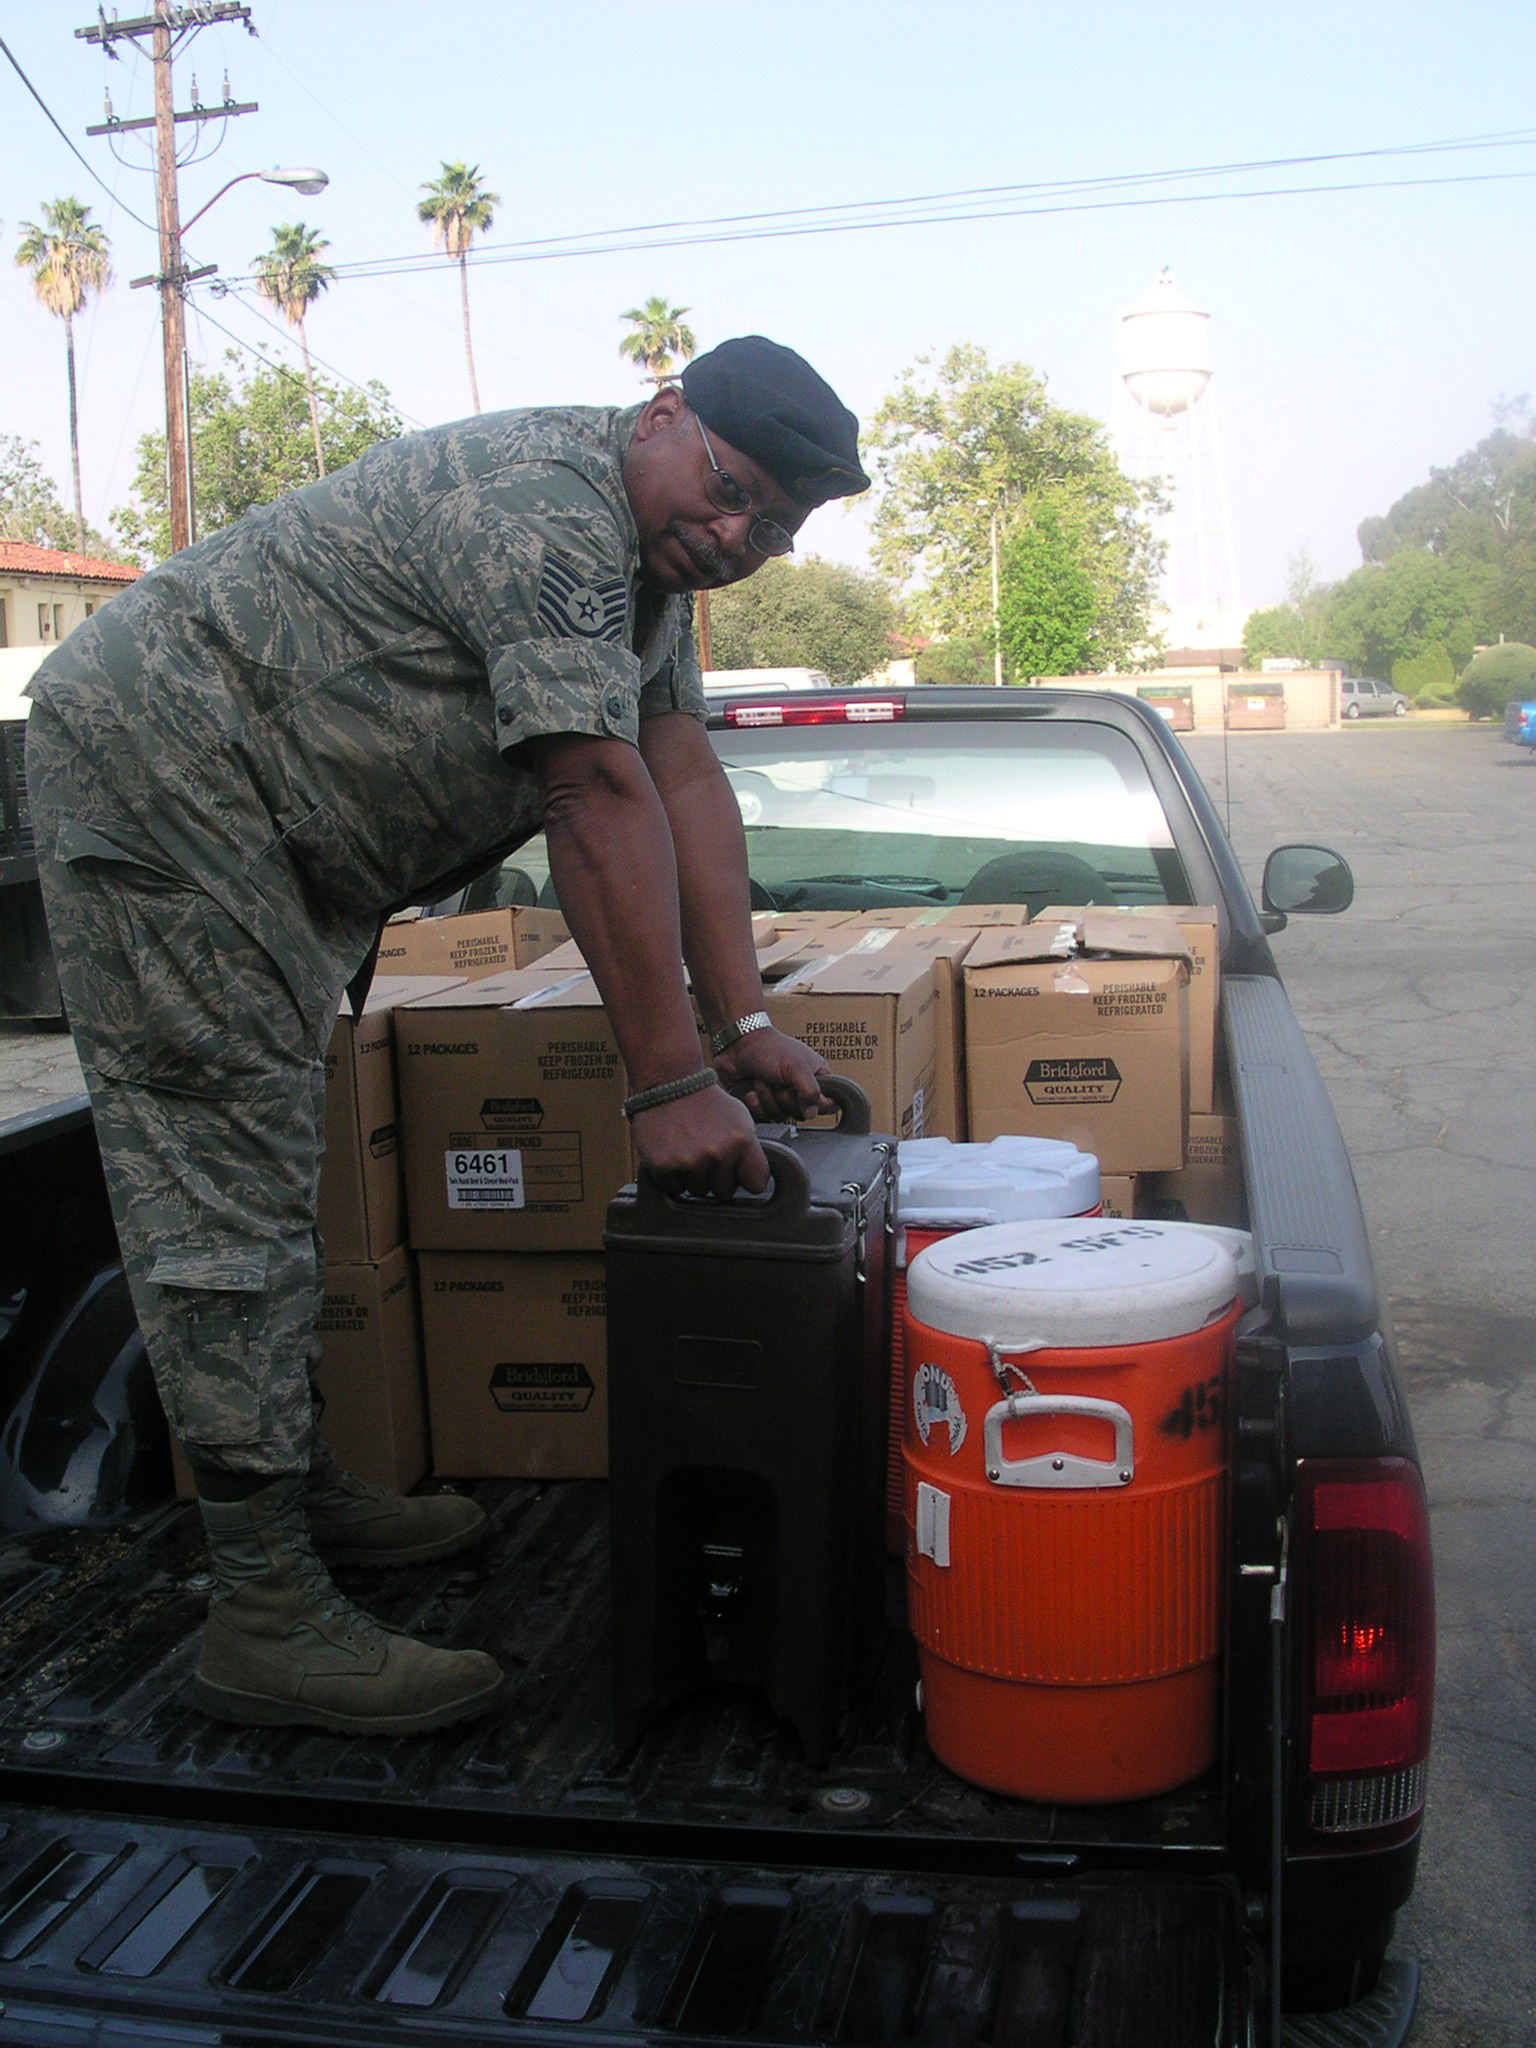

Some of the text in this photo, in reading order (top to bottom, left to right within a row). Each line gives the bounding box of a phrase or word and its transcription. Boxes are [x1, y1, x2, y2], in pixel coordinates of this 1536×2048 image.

[457, 935, 500, 949] PERISHABLE
[378, 947, 407, 959] CKAGES
[450, 949, 468, 959] KEEP
[469, 947, 497, 957] FROZEN
[454, 954, 506, 969] REFRIGERATED
[973, 986, 1040, 998] 12 PACKAGES
[1103, 982, 1157, 994] PERISHABLE
[1093, 992, 1167, 1005] KEEP FROZEN OR
[1097, 1004, 1163, 1017] REFRIGERATED
[806, 1022, 867, 1034] PERISHABLE
[548, 1041, 607, 1053] PERISHABLE
[823, 1035, 862, 1047] FROZEN
[864, 1035, 878, 1046] OR
[407, 1043, 479, 1056] 12 PACKAGES
[537, 1053, 619, 1068] KEEP FROZEN OR
[543, 1067, 614, 1081] REFRIGERATED
[1040, 1061, 1107, 1080] Bridgford
[1044, 1085, 1104, 1095] QUALITY
[455, 1154, 508, 1174] 6461
[433, 1280, 505, 1292] 12 PACKAGES
[572, 1279, 607, 1291] PERISH
[322, 1294, 357, 1305] SHABLE
[561, 1292, 607, 1304] KEEP FRO
[321, 1306, 369, 1318] ROZEN OR
[567, 1305, 607, 1317] REFRIGE
[313, 1319, 365, 1331] RIGERATED
[506, 1366, 579, 1385] Bridgford
[511, 1391, 576, 1401] QUALITY
